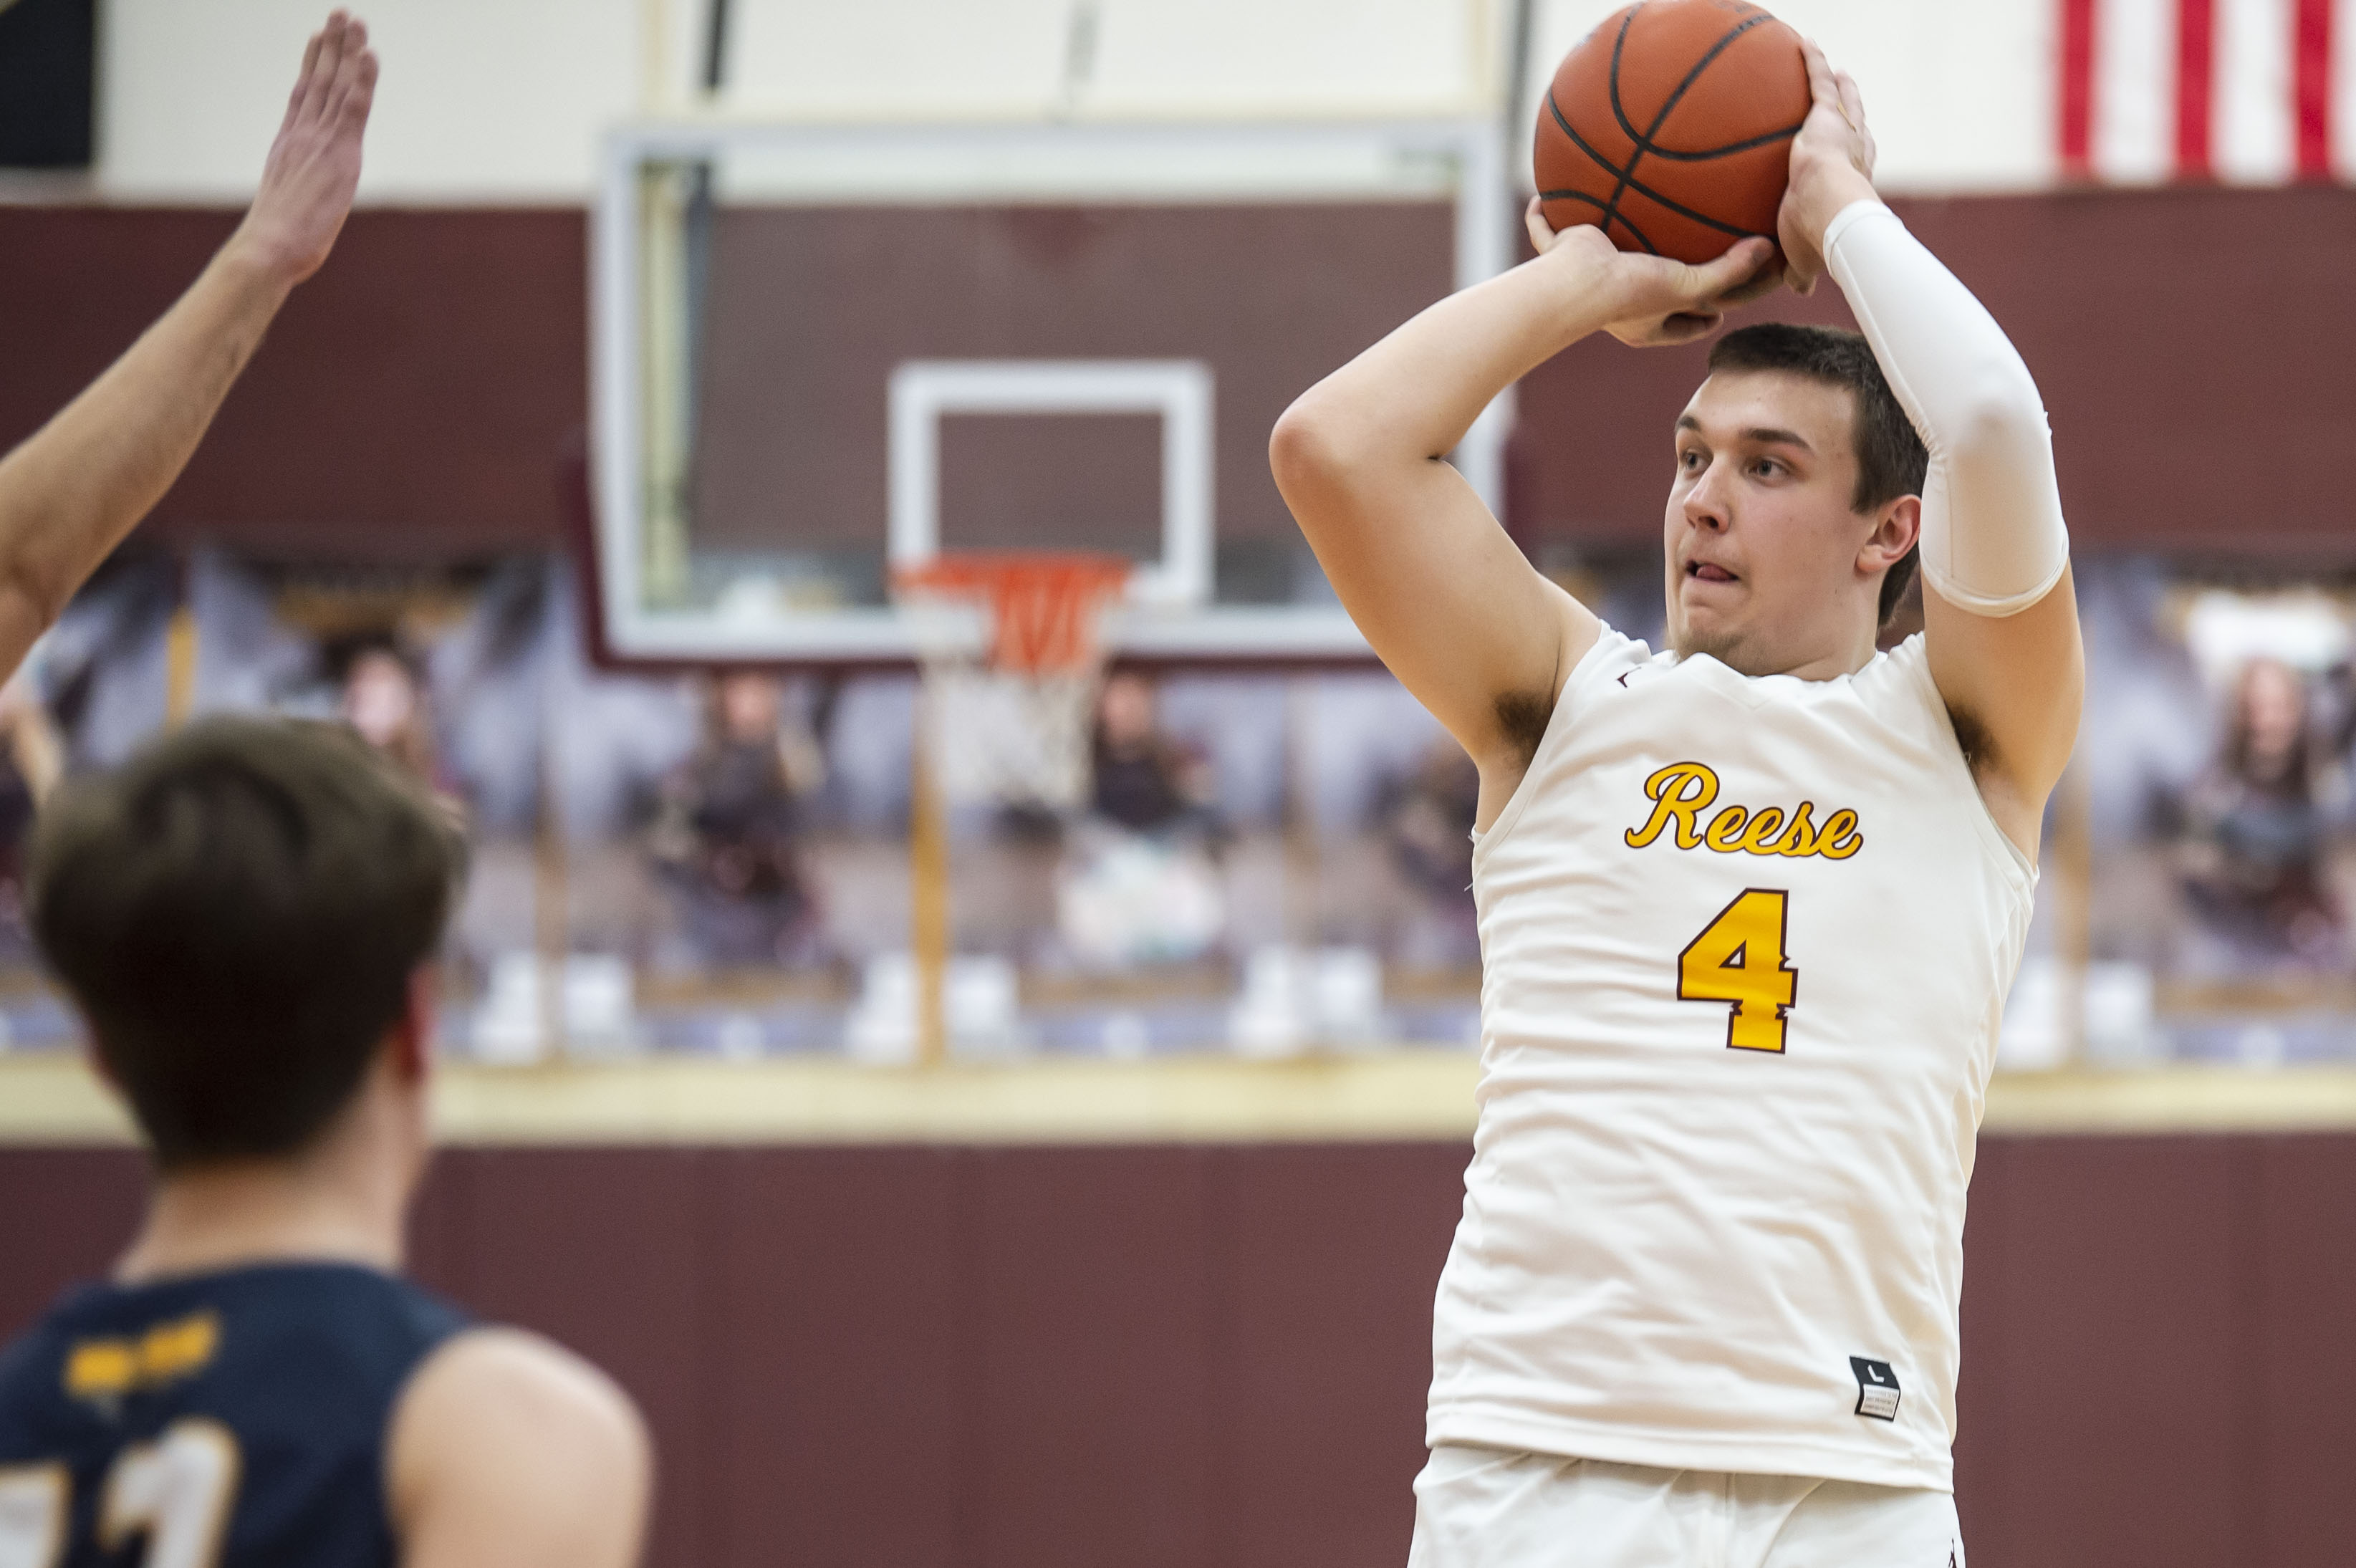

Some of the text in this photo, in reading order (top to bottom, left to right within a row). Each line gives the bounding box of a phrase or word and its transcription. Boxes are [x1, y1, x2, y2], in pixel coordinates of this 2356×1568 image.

[1624, 761, 1864, 860] Reese
[1676, 887, 1799, 1054] 4
[1867, 1365, 1884, 1382] L
